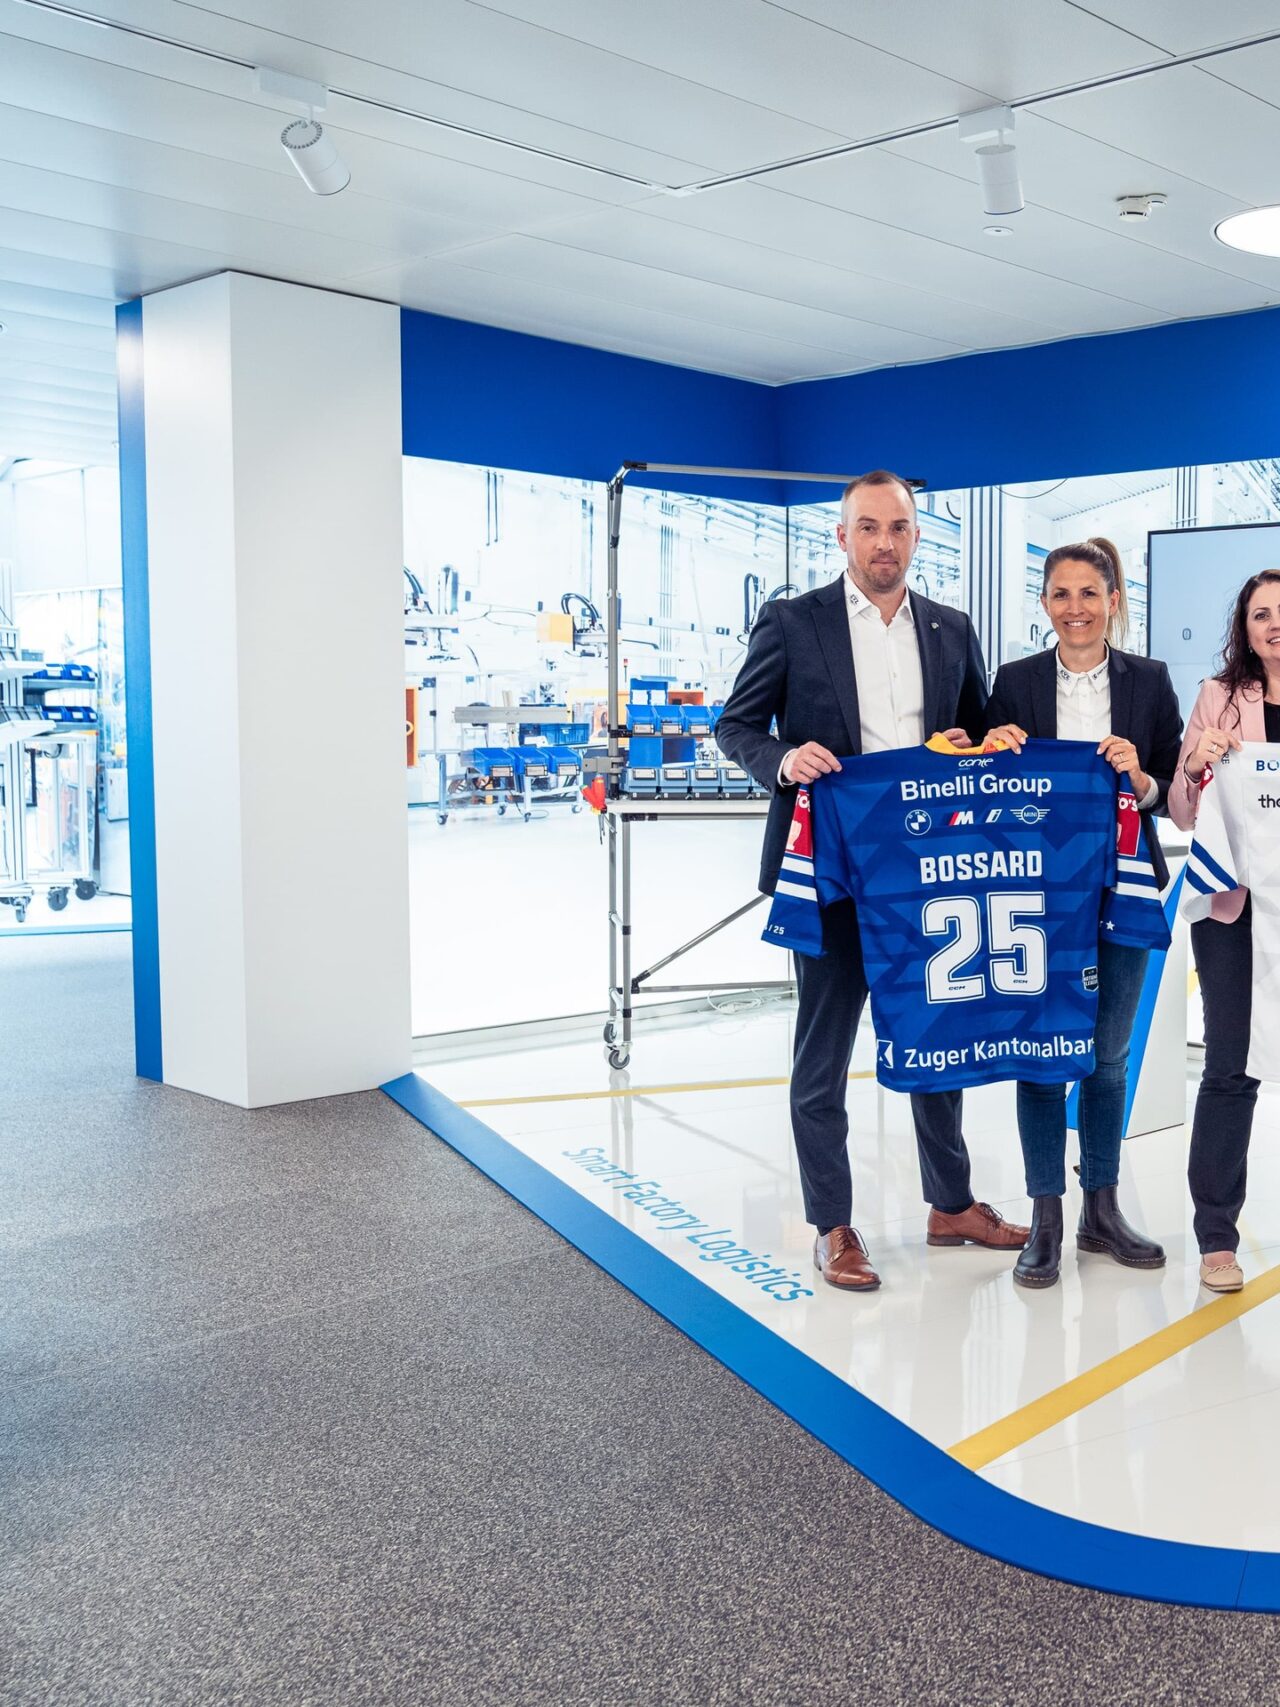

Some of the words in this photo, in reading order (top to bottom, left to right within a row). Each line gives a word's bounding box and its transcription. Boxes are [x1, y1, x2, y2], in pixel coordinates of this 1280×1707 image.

[900, 775, 975, 801] Binelli
[979, 773, 1052, 798] Group
[919, 850, 1043, 884] BOSSARD
[773, 926, 785, 935] 25
[921, 891, 1048, 1004] 25
[904, 1048, 969, 1071] Zuger
[562, 1147, 639, 1183] Smart
[612, 1181, 709, 1230] Factory
[686, 1229, 814, 1301] Logistics
